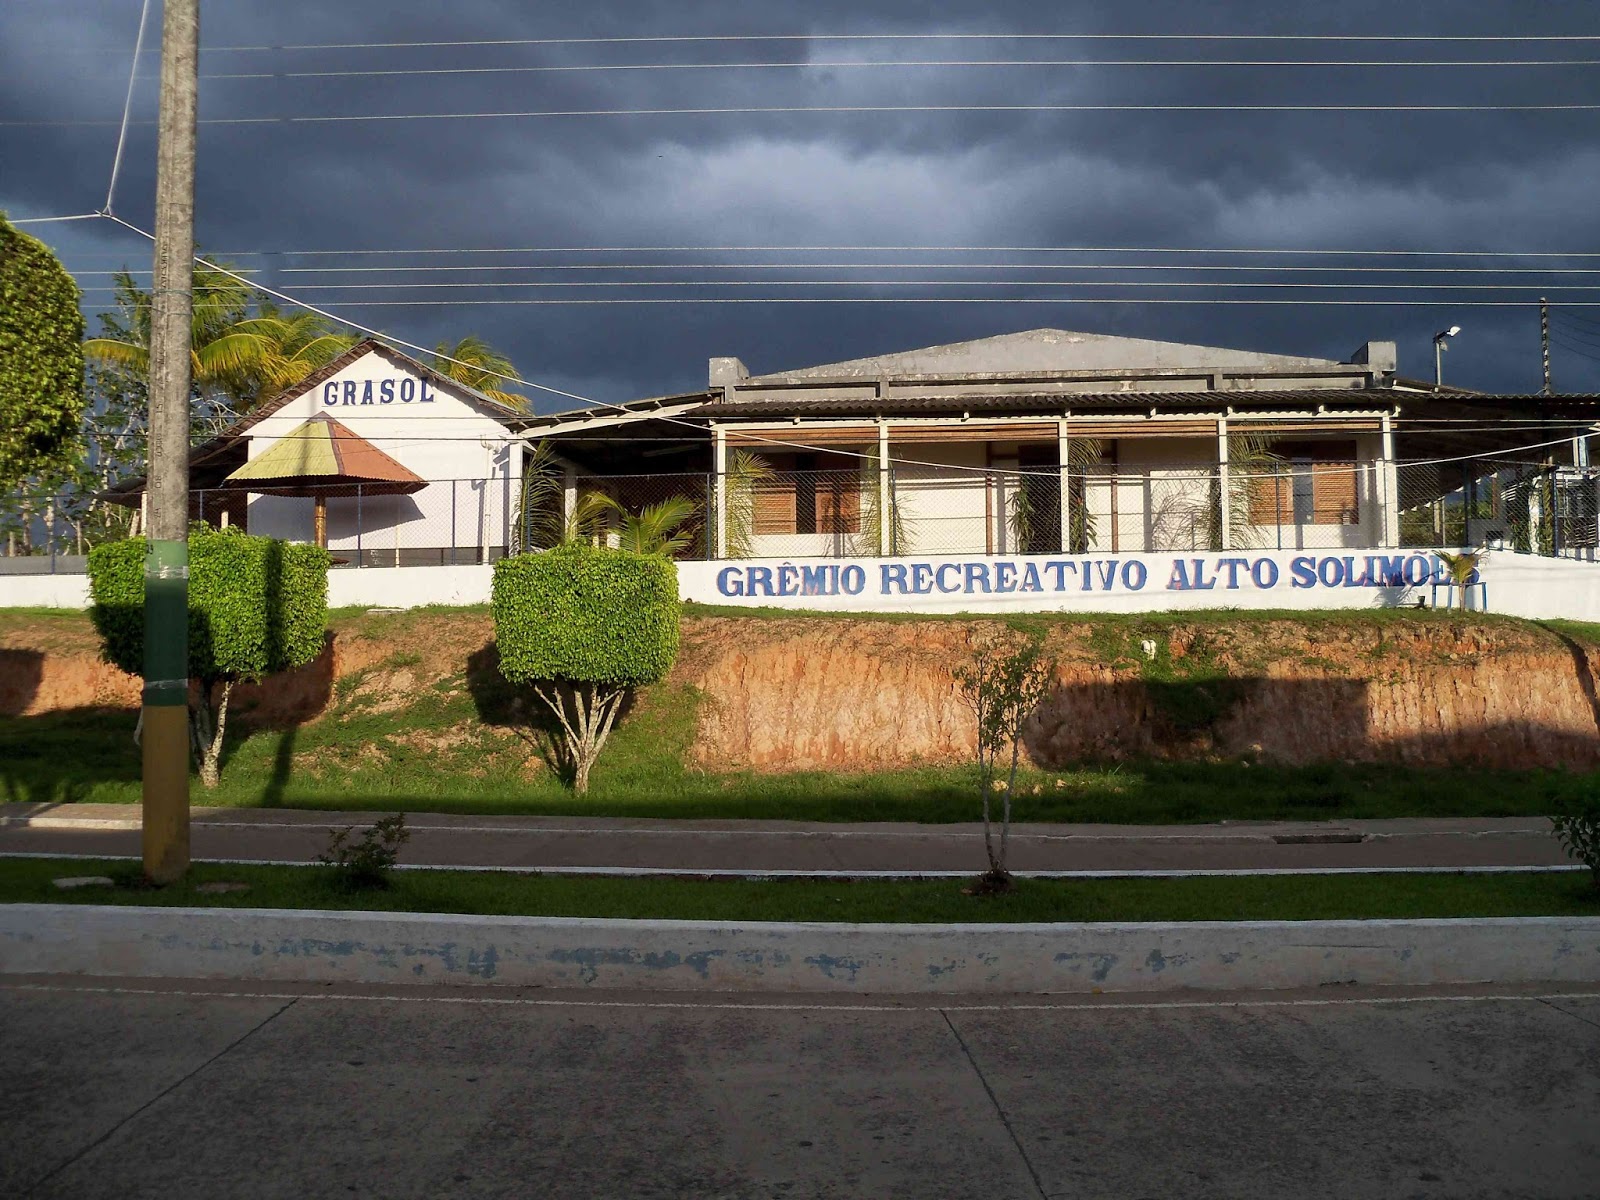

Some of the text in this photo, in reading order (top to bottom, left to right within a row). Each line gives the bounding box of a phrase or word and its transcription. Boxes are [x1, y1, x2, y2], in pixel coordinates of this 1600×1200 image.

[323, 376, 435, 406] GRASOL
[716, 561, 866, 597] GRÊMIO
[879, 560, 1148, 595] RECREATIVO
[1166, 557, 1280, 591] ALTO
